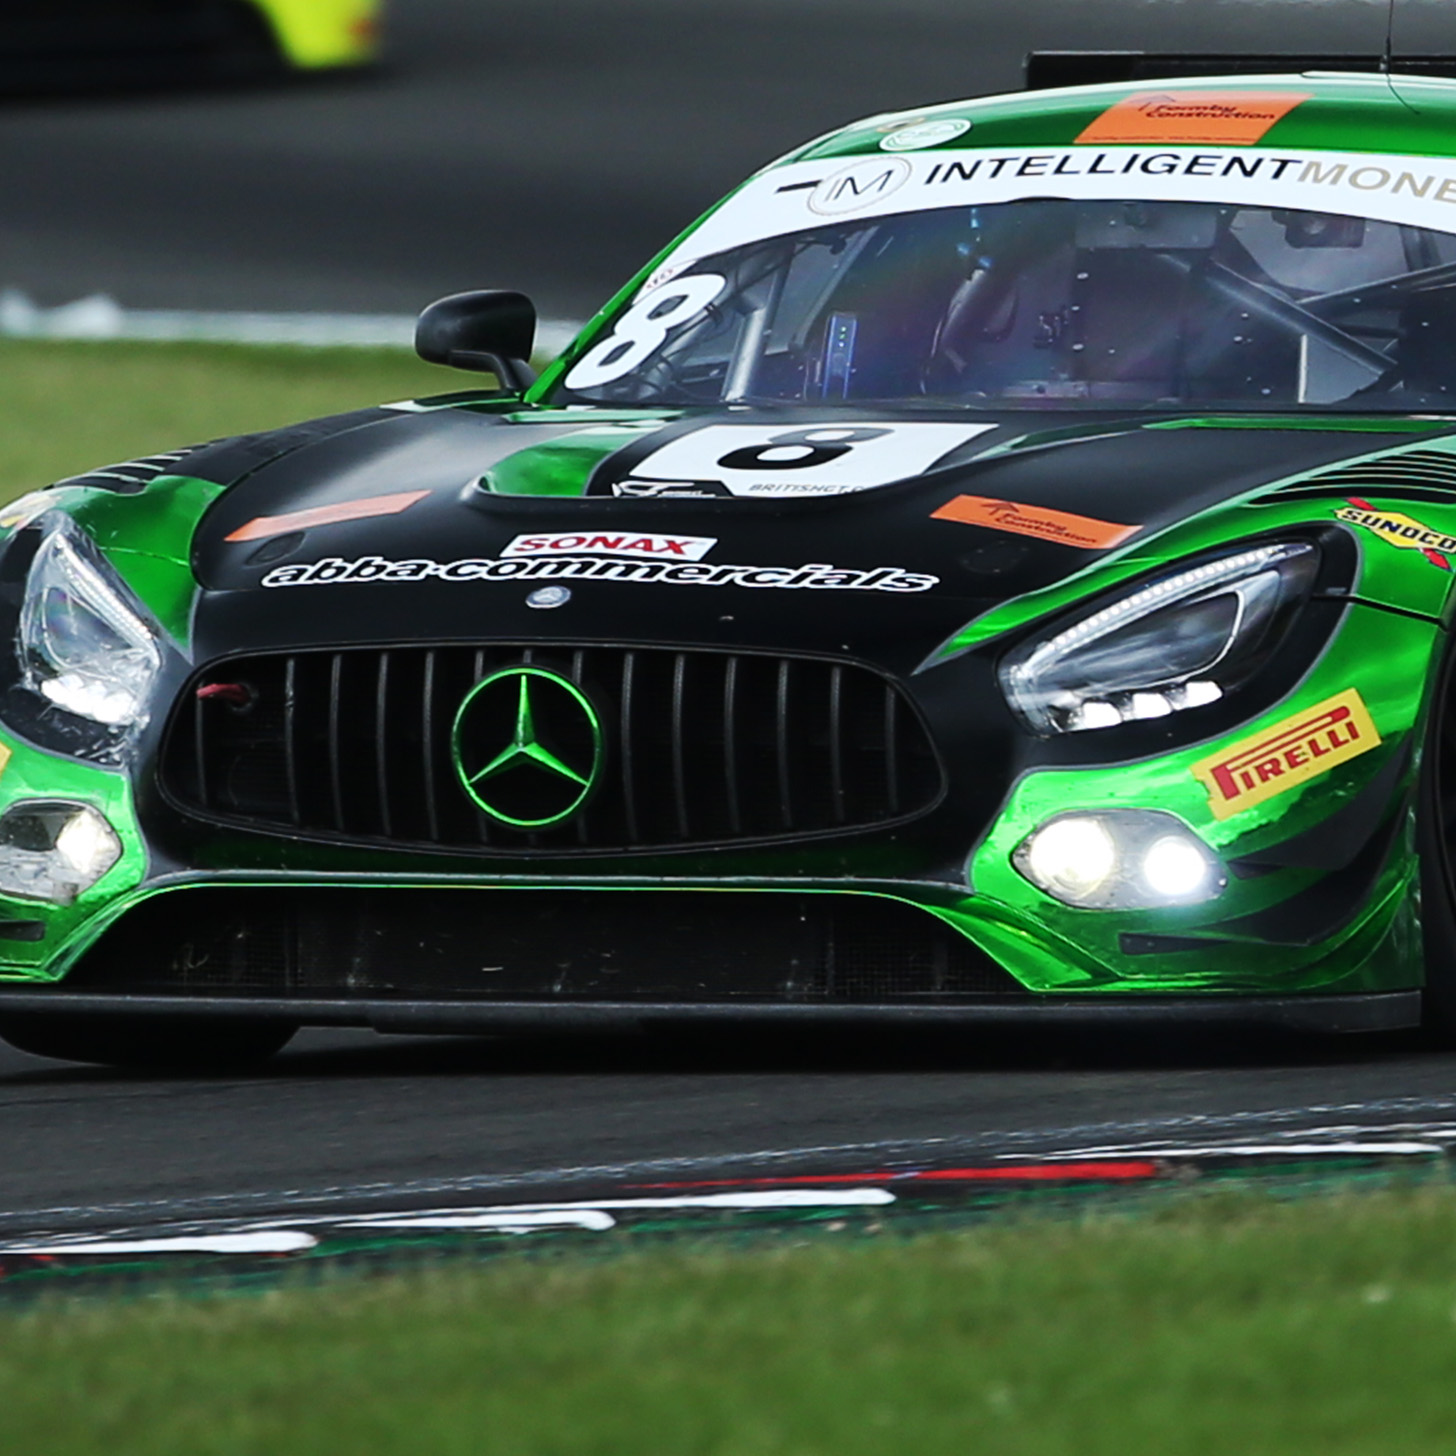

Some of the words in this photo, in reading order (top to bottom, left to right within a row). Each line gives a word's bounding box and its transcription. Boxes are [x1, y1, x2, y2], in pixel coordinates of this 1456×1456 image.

[565, 274, 726, 390] 8
[716, 427, 895, 470] 8
[514, 536, 696, 555] SONAX
[1210, 706, 1360, 801] PIRELLI
